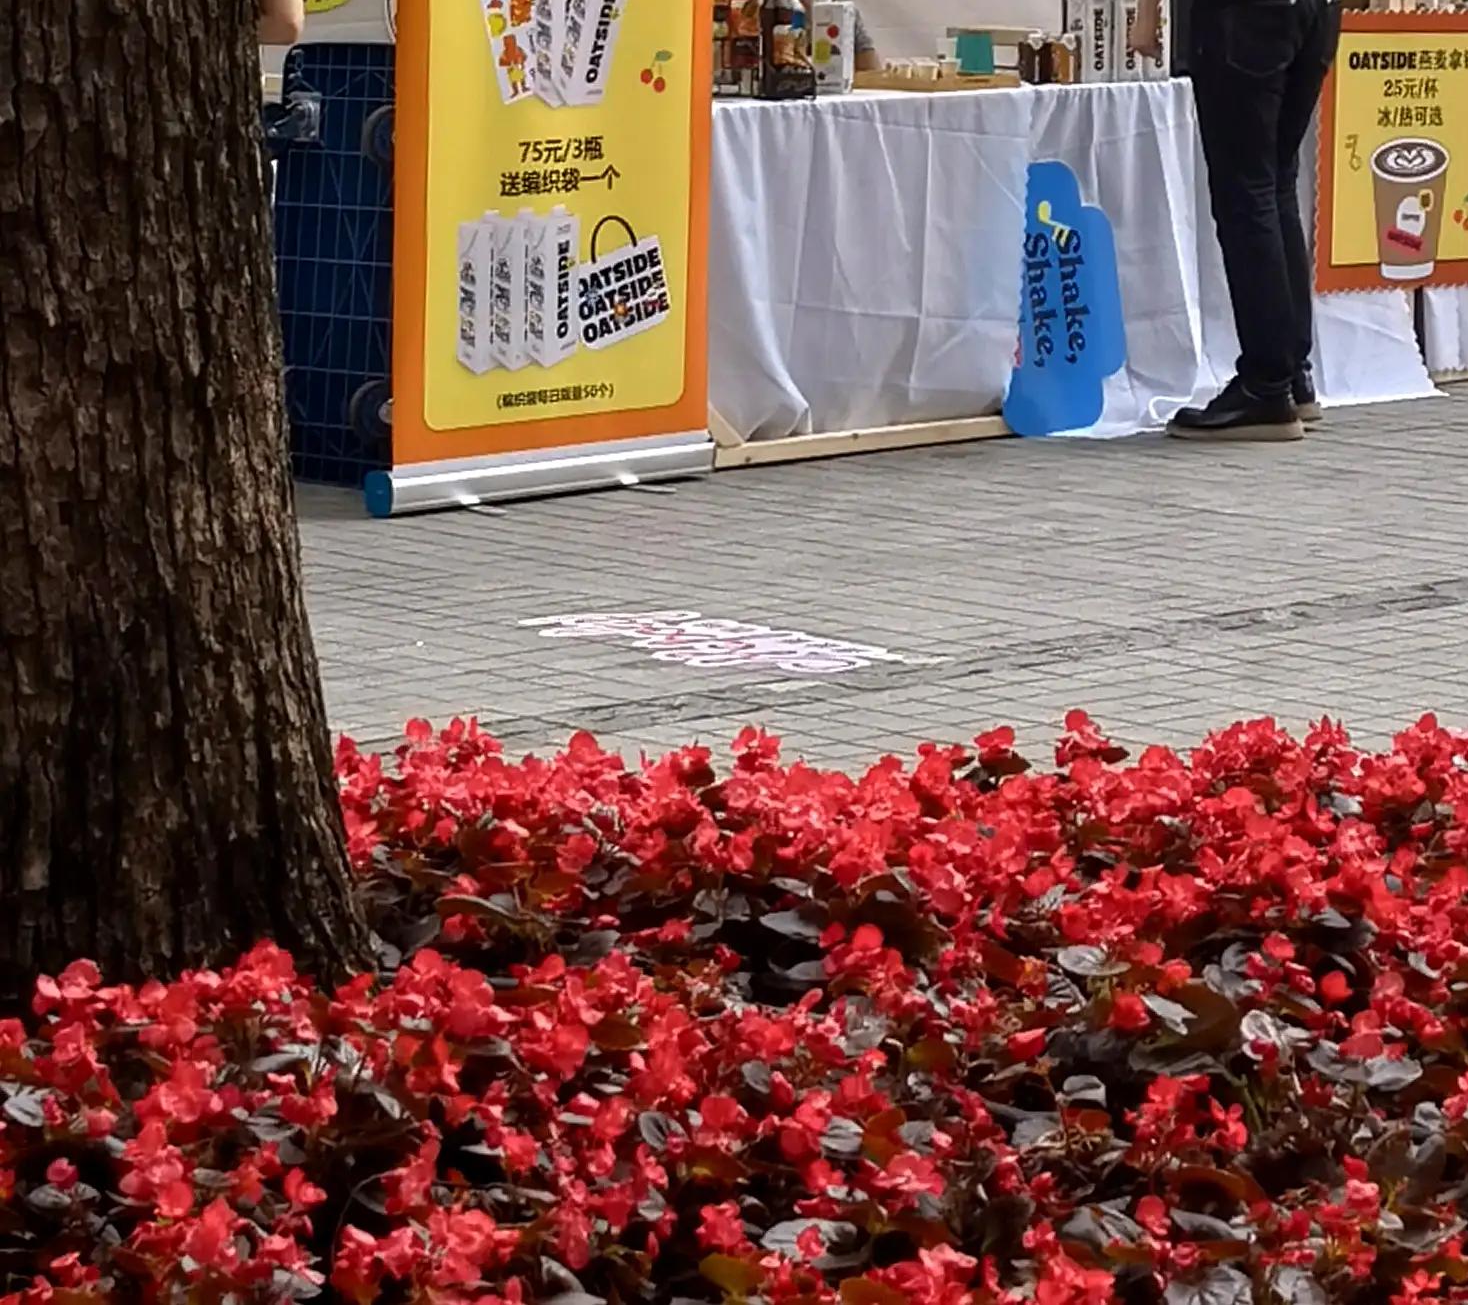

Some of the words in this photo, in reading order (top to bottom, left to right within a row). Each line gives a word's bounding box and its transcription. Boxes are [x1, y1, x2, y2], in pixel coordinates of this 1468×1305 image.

[1384, 77, 1439, 99] 25元/杯
[500, 165, 621, 197] 送编织袋一个
[518, 136, 604, 163] 75元/3瓶
[556, 240, 571, 339] OATSIDE
[1023, 232, 1058, 369] Shake,
[1055, 228, 1090, 364] Shake,
